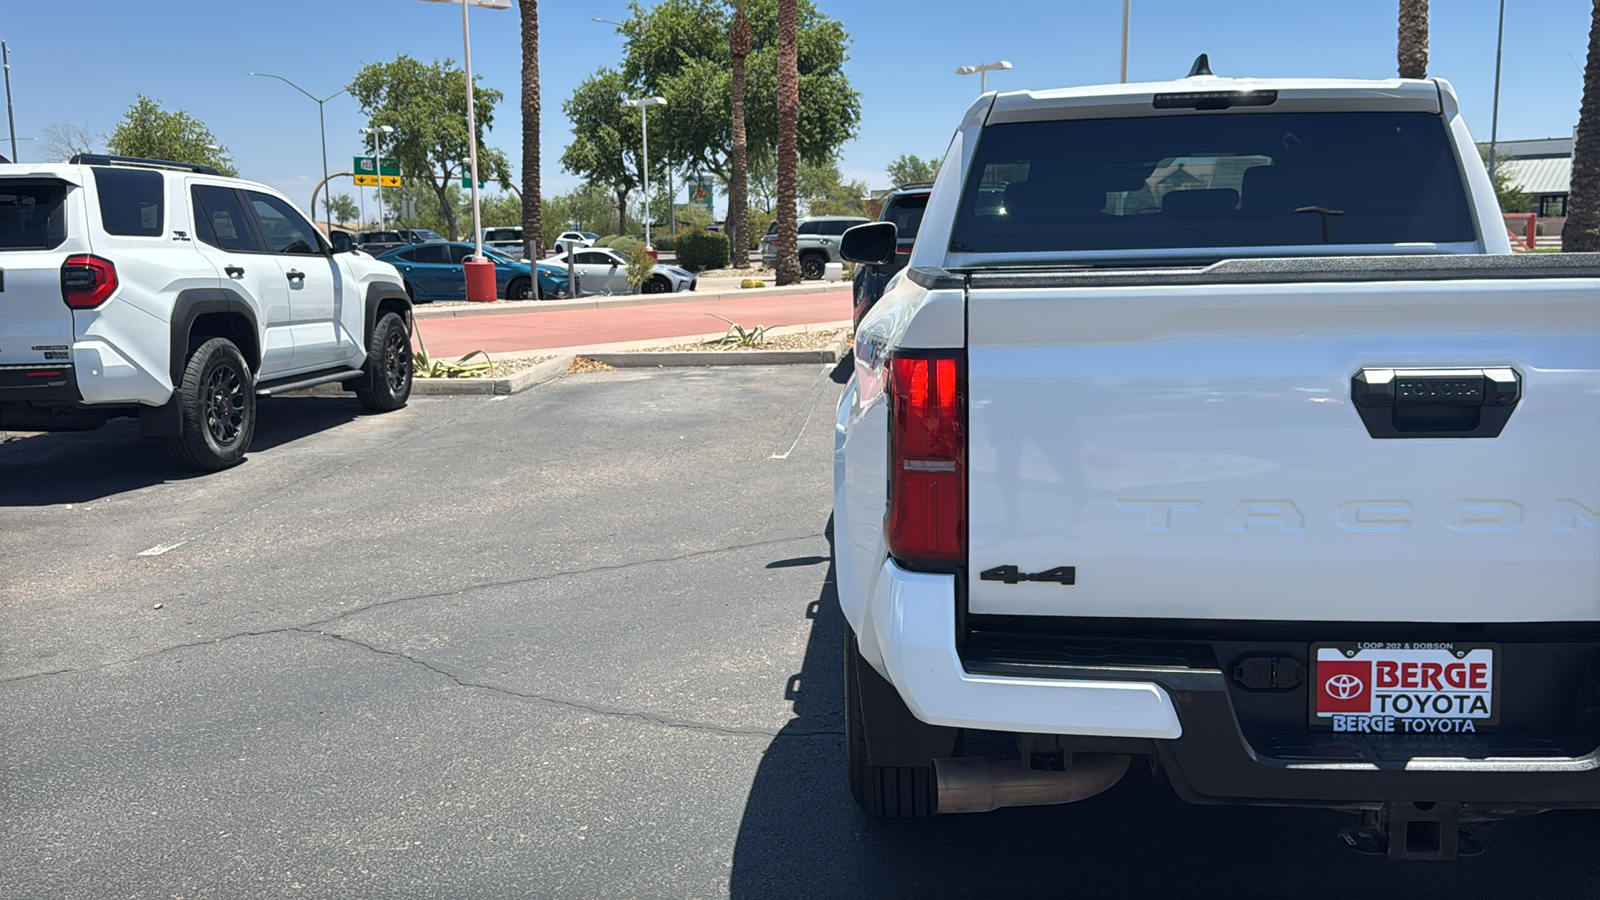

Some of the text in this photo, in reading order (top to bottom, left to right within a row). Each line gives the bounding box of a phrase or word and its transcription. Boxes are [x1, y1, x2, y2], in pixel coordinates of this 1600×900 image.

[361, 161, 373, 169] 202
[1400, 382, 1480, 396] TOYOTA
[1375, 661, 1487, 691] BERGE
[1375, 694, 1489, 714] TOYOTA
[1333, 715, 1476, 733] BERGE TOYOTA
